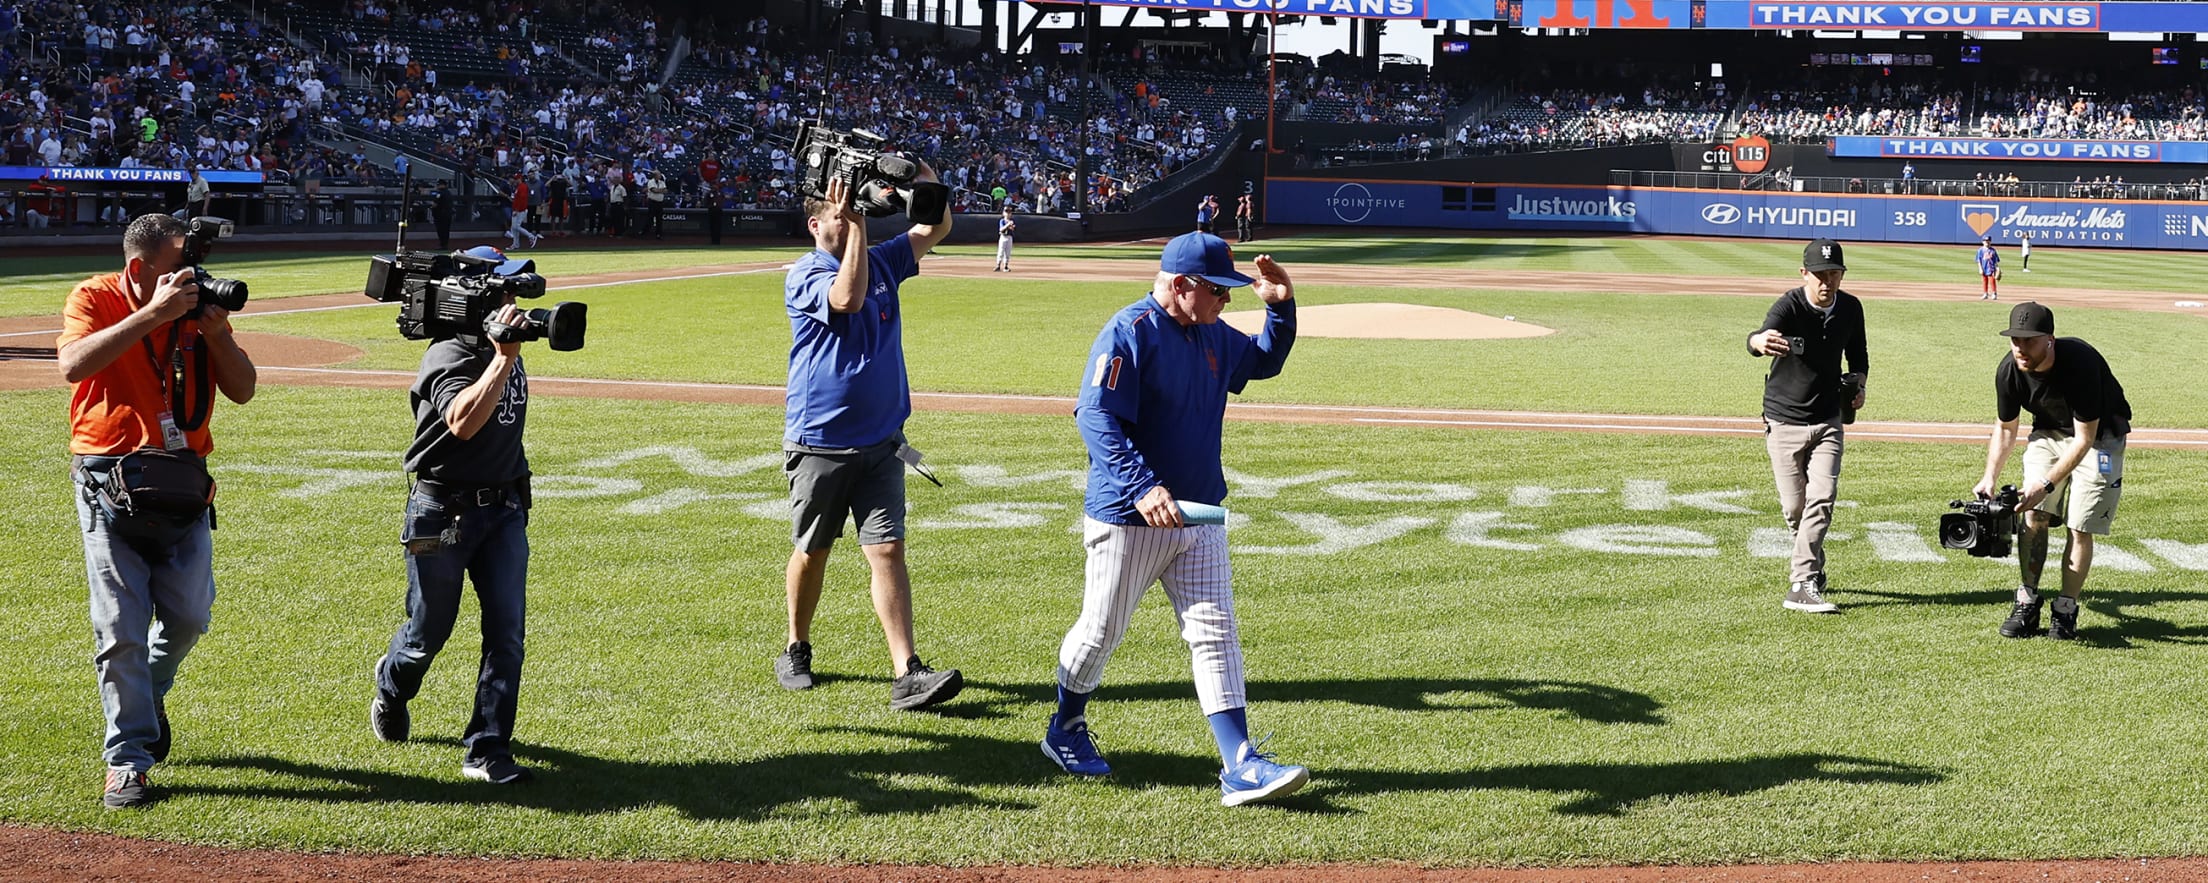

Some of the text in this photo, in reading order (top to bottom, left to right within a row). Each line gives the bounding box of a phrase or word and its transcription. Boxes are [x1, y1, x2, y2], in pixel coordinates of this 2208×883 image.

[1758, 6, 2091, 25] THANK YOU FANS
[1703, 148, 1730, 164] citi
[1739, 147, 1764, 160] 115
[1890, 141, 2151, 158] THANK YOU FANS
[52, 169, 181, 180] THANK YOU FANS
[1326, 198, 1405, 208] 1POINTFIVE
[1508, 194, 1637, 217] Justworks
[1747, 207, 1856, 227] HYUNDAI
[1894, 211, 1927, 226] 358
[2001, 205, 2126, 229] Amazin' Mets
[2002, 229, 2124, 241] FOUNDATION
[1092, 353, 1123, 391] 11
